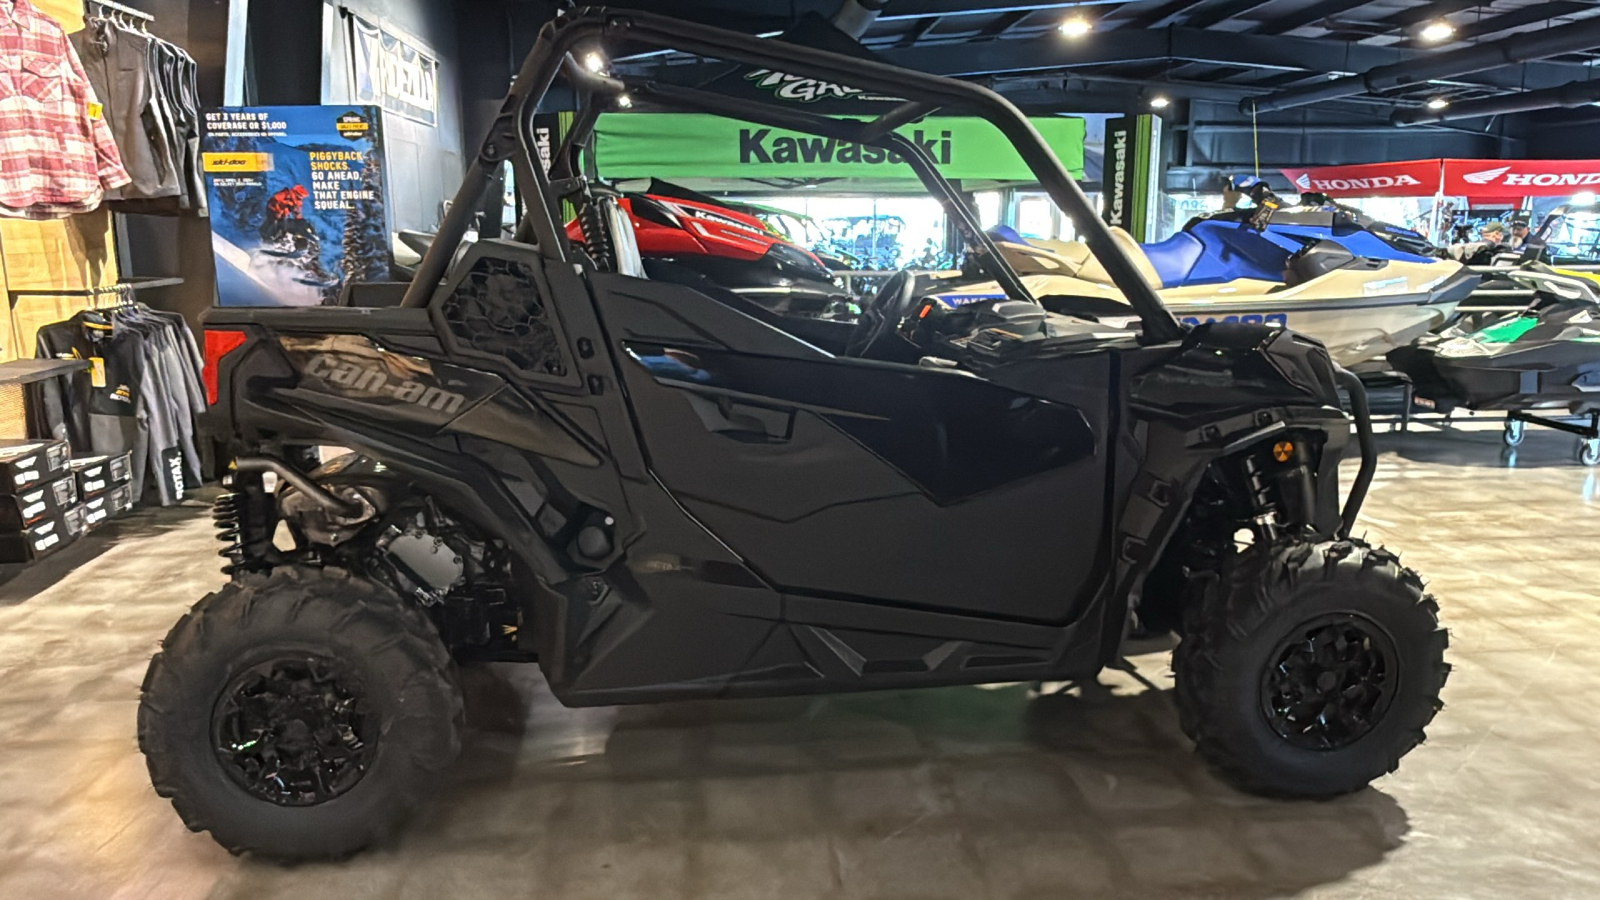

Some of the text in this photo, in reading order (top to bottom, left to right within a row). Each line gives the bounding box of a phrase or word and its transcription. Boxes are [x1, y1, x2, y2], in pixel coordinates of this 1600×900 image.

[205, 112, 269, 121] GET 3 YEARS OF
[206, 121, 248, 130] COVERAGE
[249, 121, 260, 130] OR
[309, 151, 363, 161] PIGGYBACK
[311, 171, 362, 182] GO AHEAD,
[1110, 131, 1127, 225] Kawasaki
[312, 181, 340, 190] MAKE
[1312, 174, 1421, 190] HONDA
[313, 190, 374, 200] THAT ENGINE
